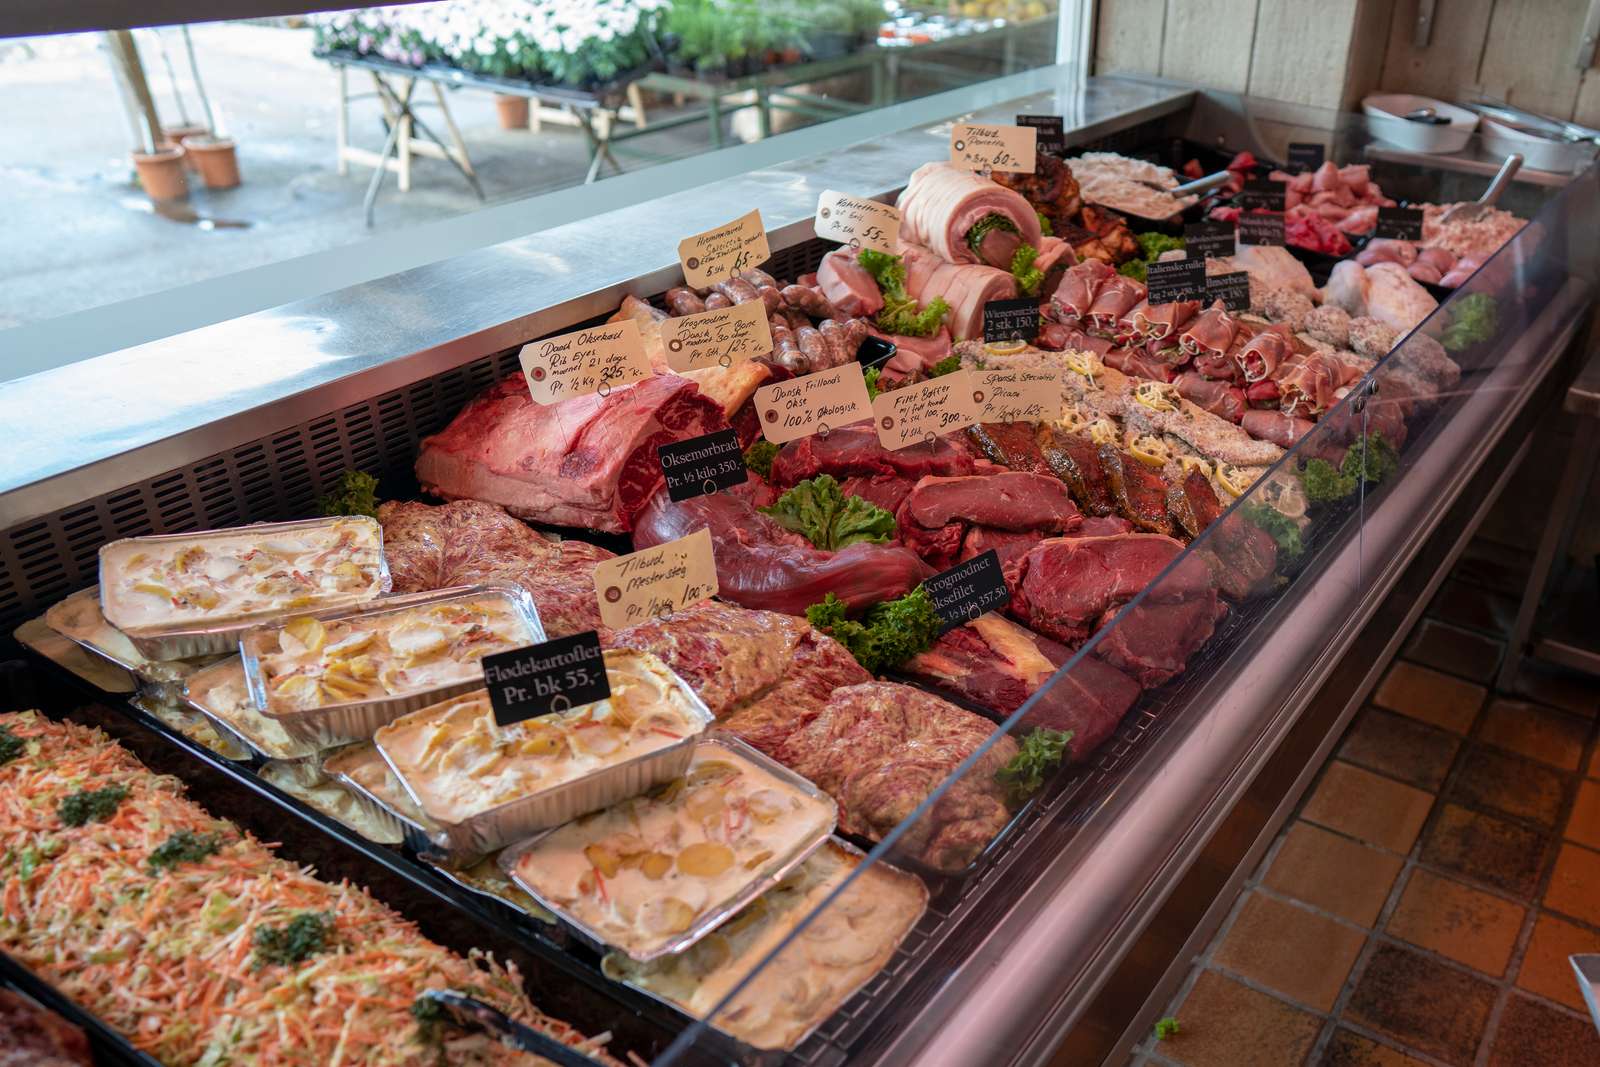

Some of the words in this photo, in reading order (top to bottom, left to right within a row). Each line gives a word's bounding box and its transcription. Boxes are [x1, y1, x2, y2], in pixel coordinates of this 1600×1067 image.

[589, 358, 601, 368] 21
[771, 386, 802, 403] Dansk
[786, 398, 808, 410] Okse
[661, 436, 739, 468] Oksemørbrad
[667, 476, 684, 488] Pr.
[696, 465, 717, 480] kilo
[925, 558, 991, 593] Krogmodnet
[485, 645, 600, 685] Flødekartofler
[503, 685, 533, 705] Pr.
[534, 675, 563, 696] bk
[565, 668, 601, 690] 55,-
